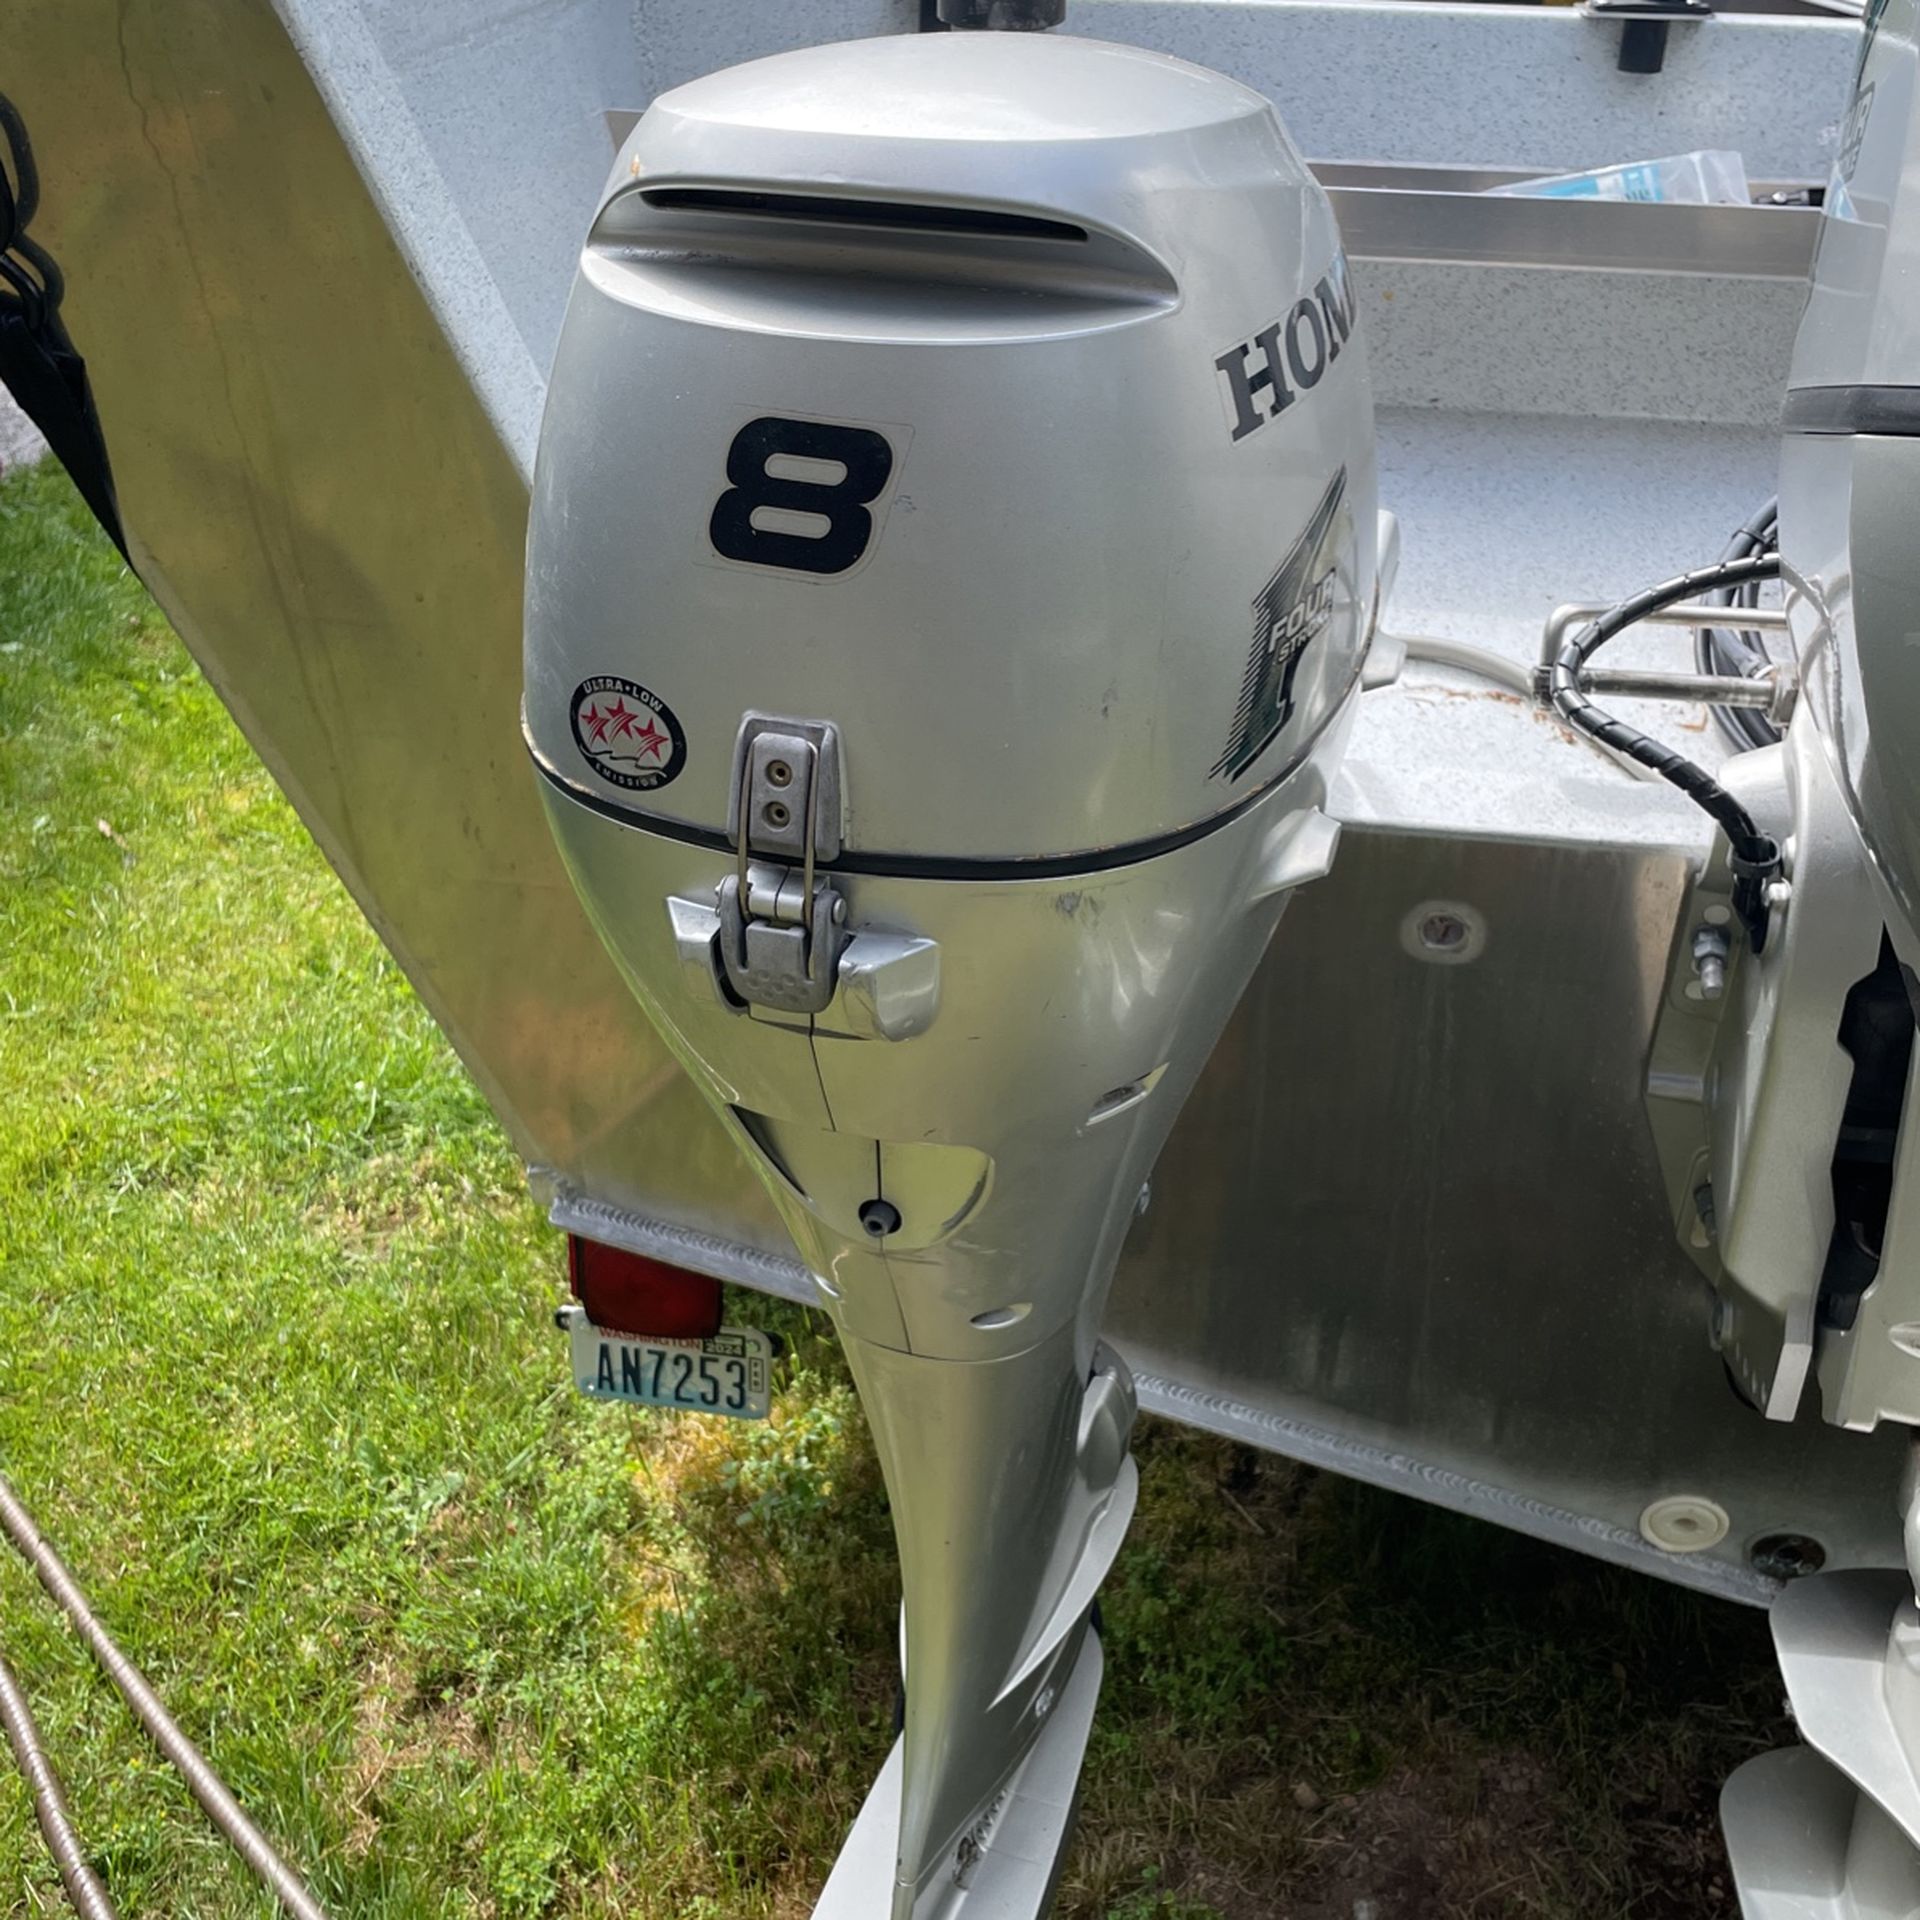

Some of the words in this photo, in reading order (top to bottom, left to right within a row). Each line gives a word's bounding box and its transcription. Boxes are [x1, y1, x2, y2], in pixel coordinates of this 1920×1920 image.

[710, 416, 893, 574] 8
[1268, 571, 1335, 653] FOUR
[583, 678, 623, 694] ULTRA
[632, 686, 663, 712] LOW
[598, 1343, 746, 1410] AN7253
[705, 1340, 743, 1356] 2024
